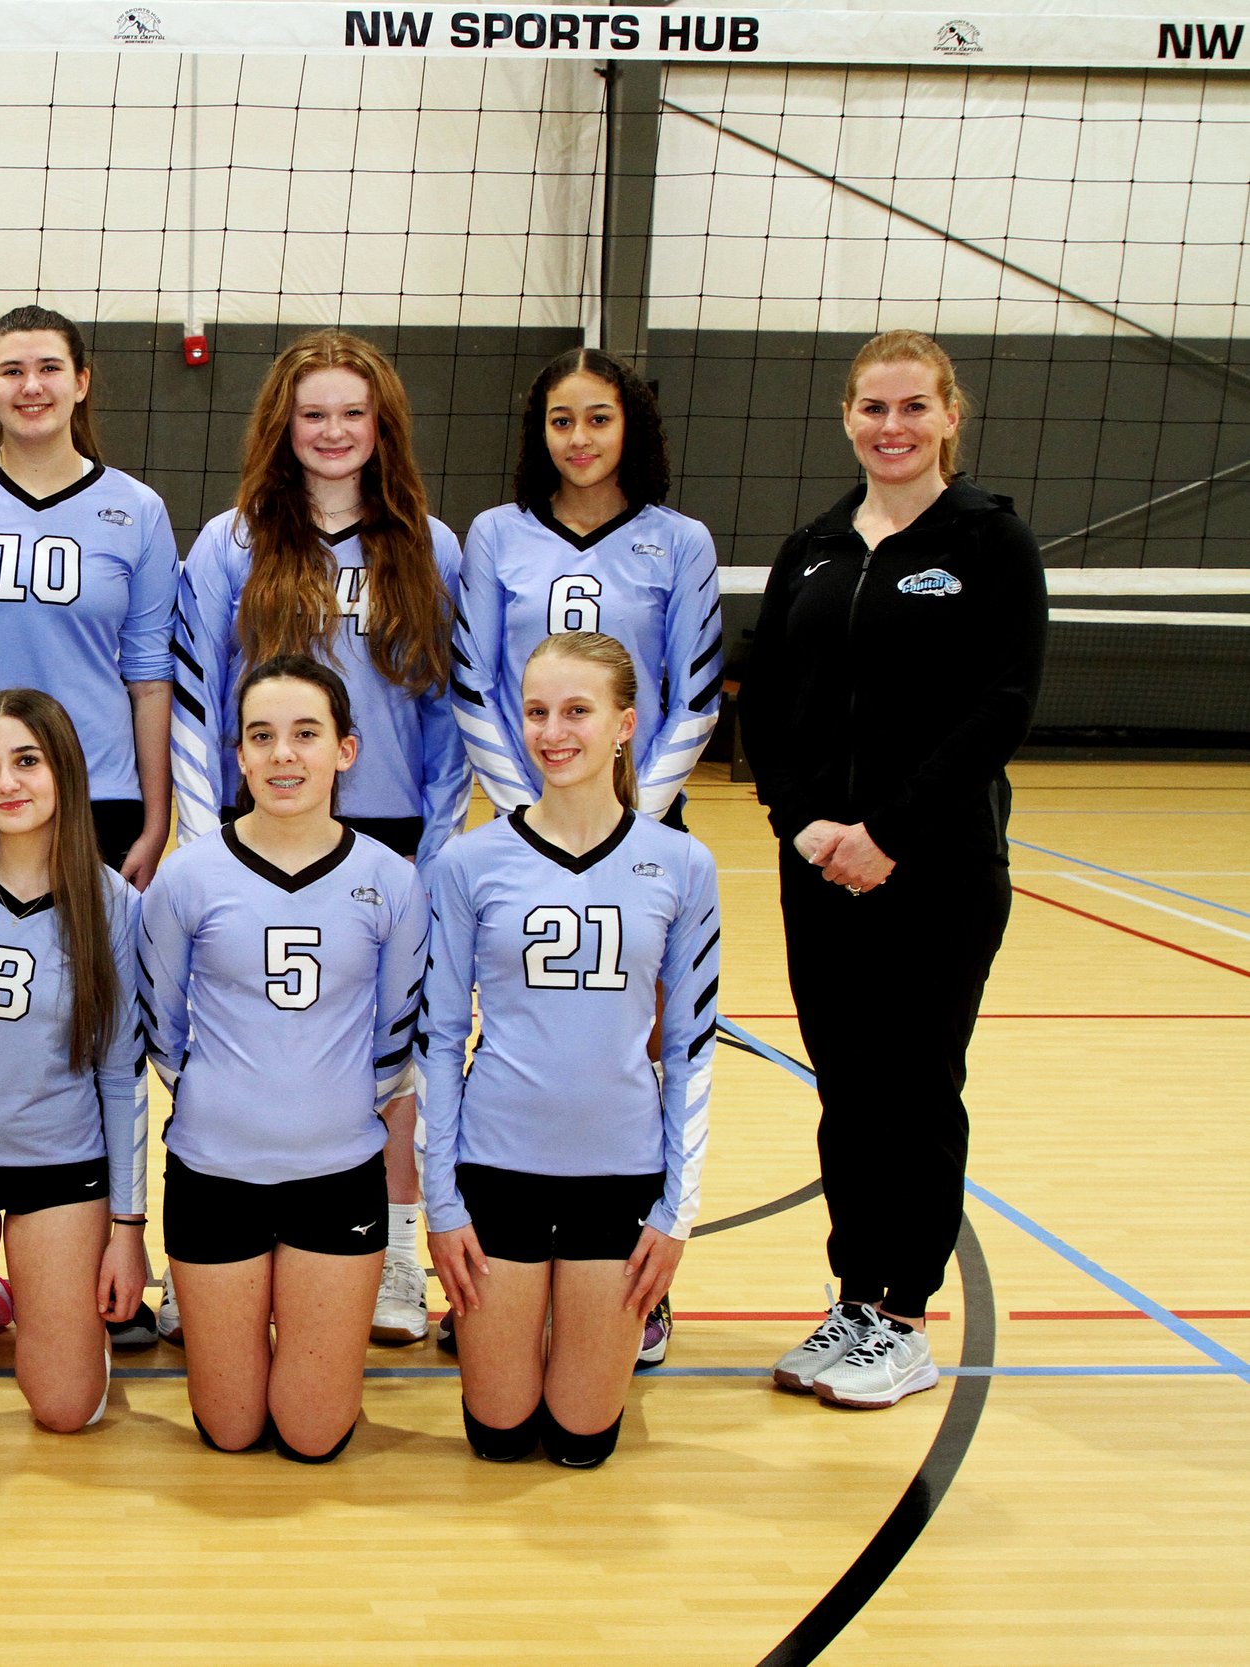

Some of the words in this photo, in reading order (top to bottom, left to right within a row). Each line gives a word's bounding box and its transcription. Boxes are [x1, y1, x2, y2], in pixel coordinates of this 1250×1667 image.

[345, 11, 433, 47] NW
[450, 12, 640, 50] SPORTS
[658, 15, 760, 52] HUB
[1157, 23, 1245, 60] NW
[547, 574, 601, 635] 6
[264, 926, 321, 1011] 5
[523, 905, 627, 990] 21
